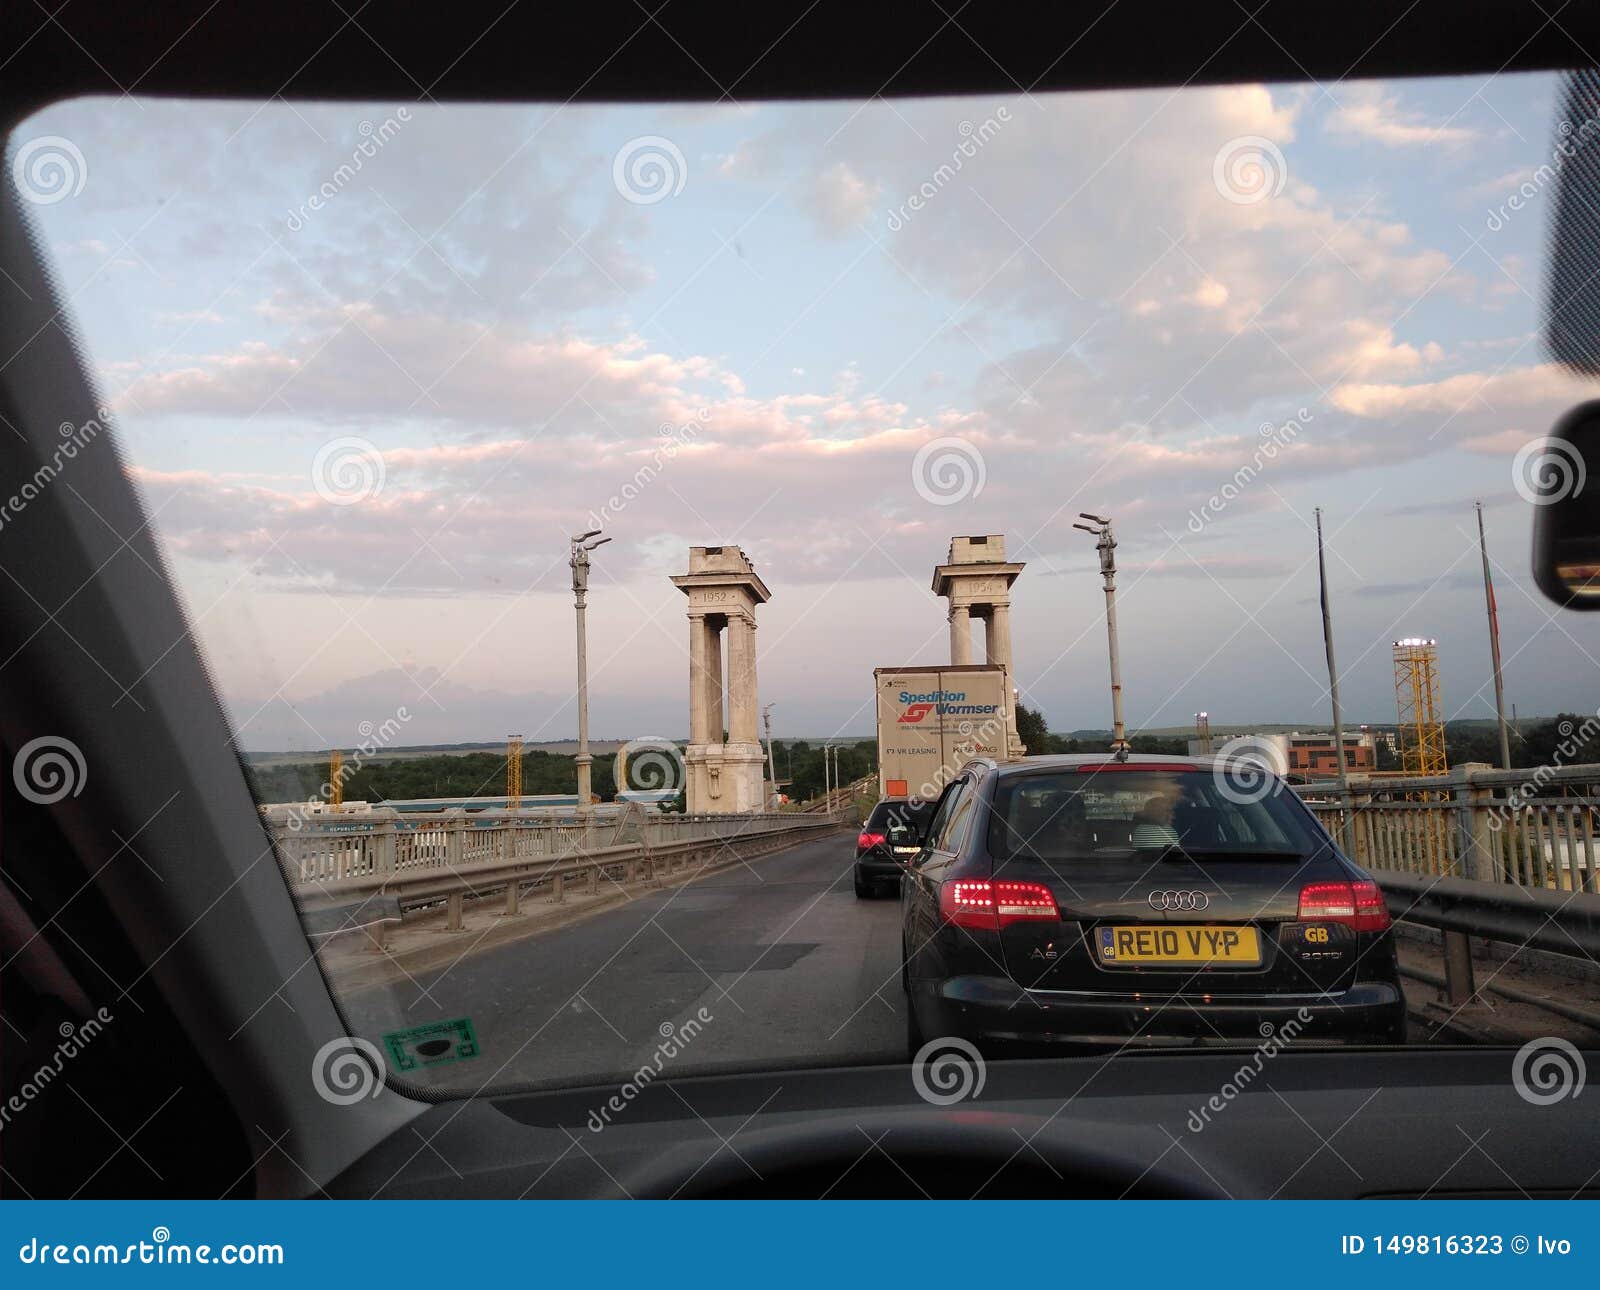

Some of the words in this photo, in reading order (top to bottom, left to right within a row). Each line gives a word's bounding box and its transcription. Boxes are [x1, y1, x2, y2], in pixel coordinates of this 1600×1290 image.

[703, 591, 727, 602] 1952
[898, 690, 966, 705] Spedition
[935, 703, 998, 715] Wormser
[908, 747, 937, 755] LEASING
[1304, 927, 1329, 942] GB
[1117, 930, 1179, 956] RE10
[1186, 930, 1239, 956] VYP
[1031, 944, 1057, 960] A6
[1103, 946, 1115, 956] GB
